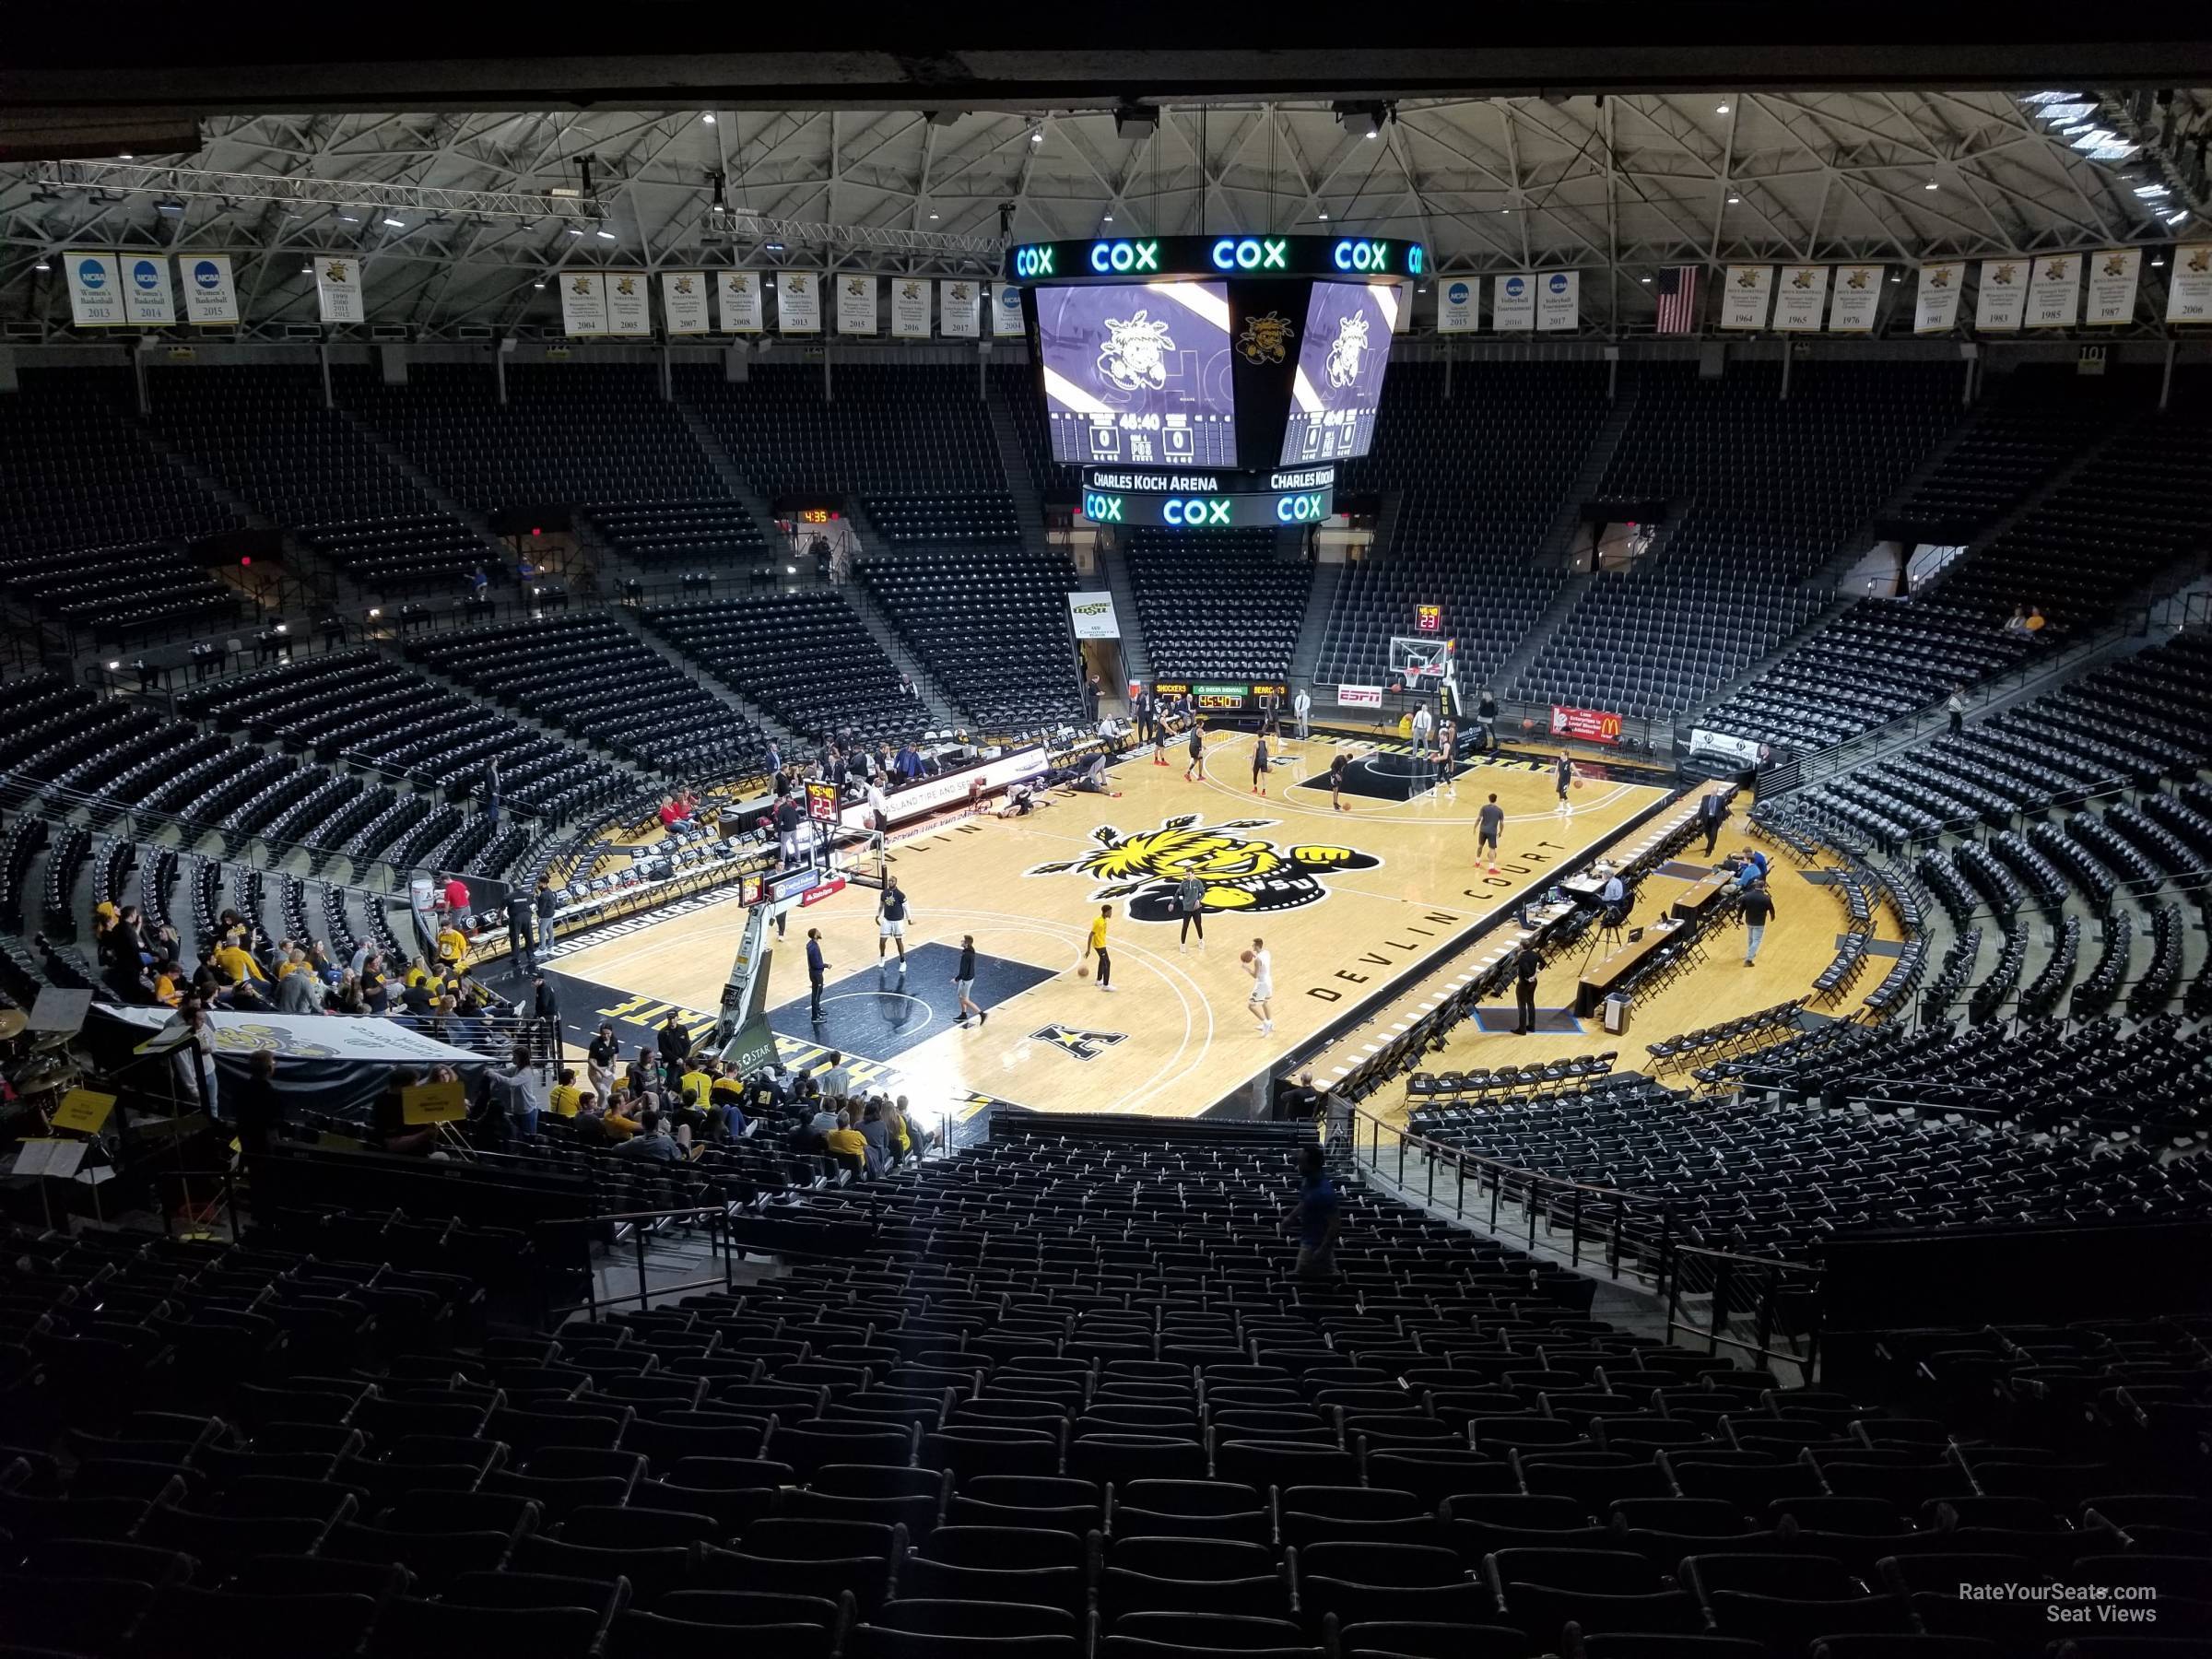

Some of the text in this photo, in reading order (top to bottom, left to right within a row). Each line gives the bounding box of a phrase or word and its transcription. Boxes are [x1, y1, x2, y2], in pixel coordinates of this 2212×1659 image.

[1018, 246, 1053, 276] COX
[1091, 242, 1158, 272] COX
[1212, 240, 1286, 269] COX
[1335, 241, 1386, 270] COX
[1408, 245, 1423, 274] CO
[88, 308, 111, 318] 2013
[141, 308, 162, 318] 2014
[203, 306, 223, 316] 2015
[2041, 311, 2061, 319] 1985
[2101, 308, 2120, 317] 1987
[2183, 303, 2204, 314] 2006
[733, 318, 750, 326] 2008
[1450, 318, 1467, 326] 2015
[2080, 346, 2107, 360] 101
[1094, 472, 1218, 491] CHARLES KOCH ARENA
[1271, 471, 1314, 488] CHARLES
[1087, 493, 1122, 521] COX
[1163, 499, 1230, 524] COX
[1277, 494, 1321, 522] COX
[805, 512, 827, 523] 4:35
[1420, 615, 1435, 629] 23
[1157, 685, 1186, 693] SHOCKERS
[1253, 686, 1285, 694] BEARCS
[1340, 690, 1381, 702] ESPN
[1199, 695, 1230, 708] 45:40
[1440, 686, 1449, 715] WSU
[1463, 755, 1559, 773] STAT
[808, 784, 834, 797] 45:40
[812, 797, 832, 818] 23
[1235, 877, 1314, 892] WSU
[1307, 840, 1565, 1003] DEVLIN COURT
[751, 1043, 771, 1061] STAR
[758, 1090, 772, 1105] 21
